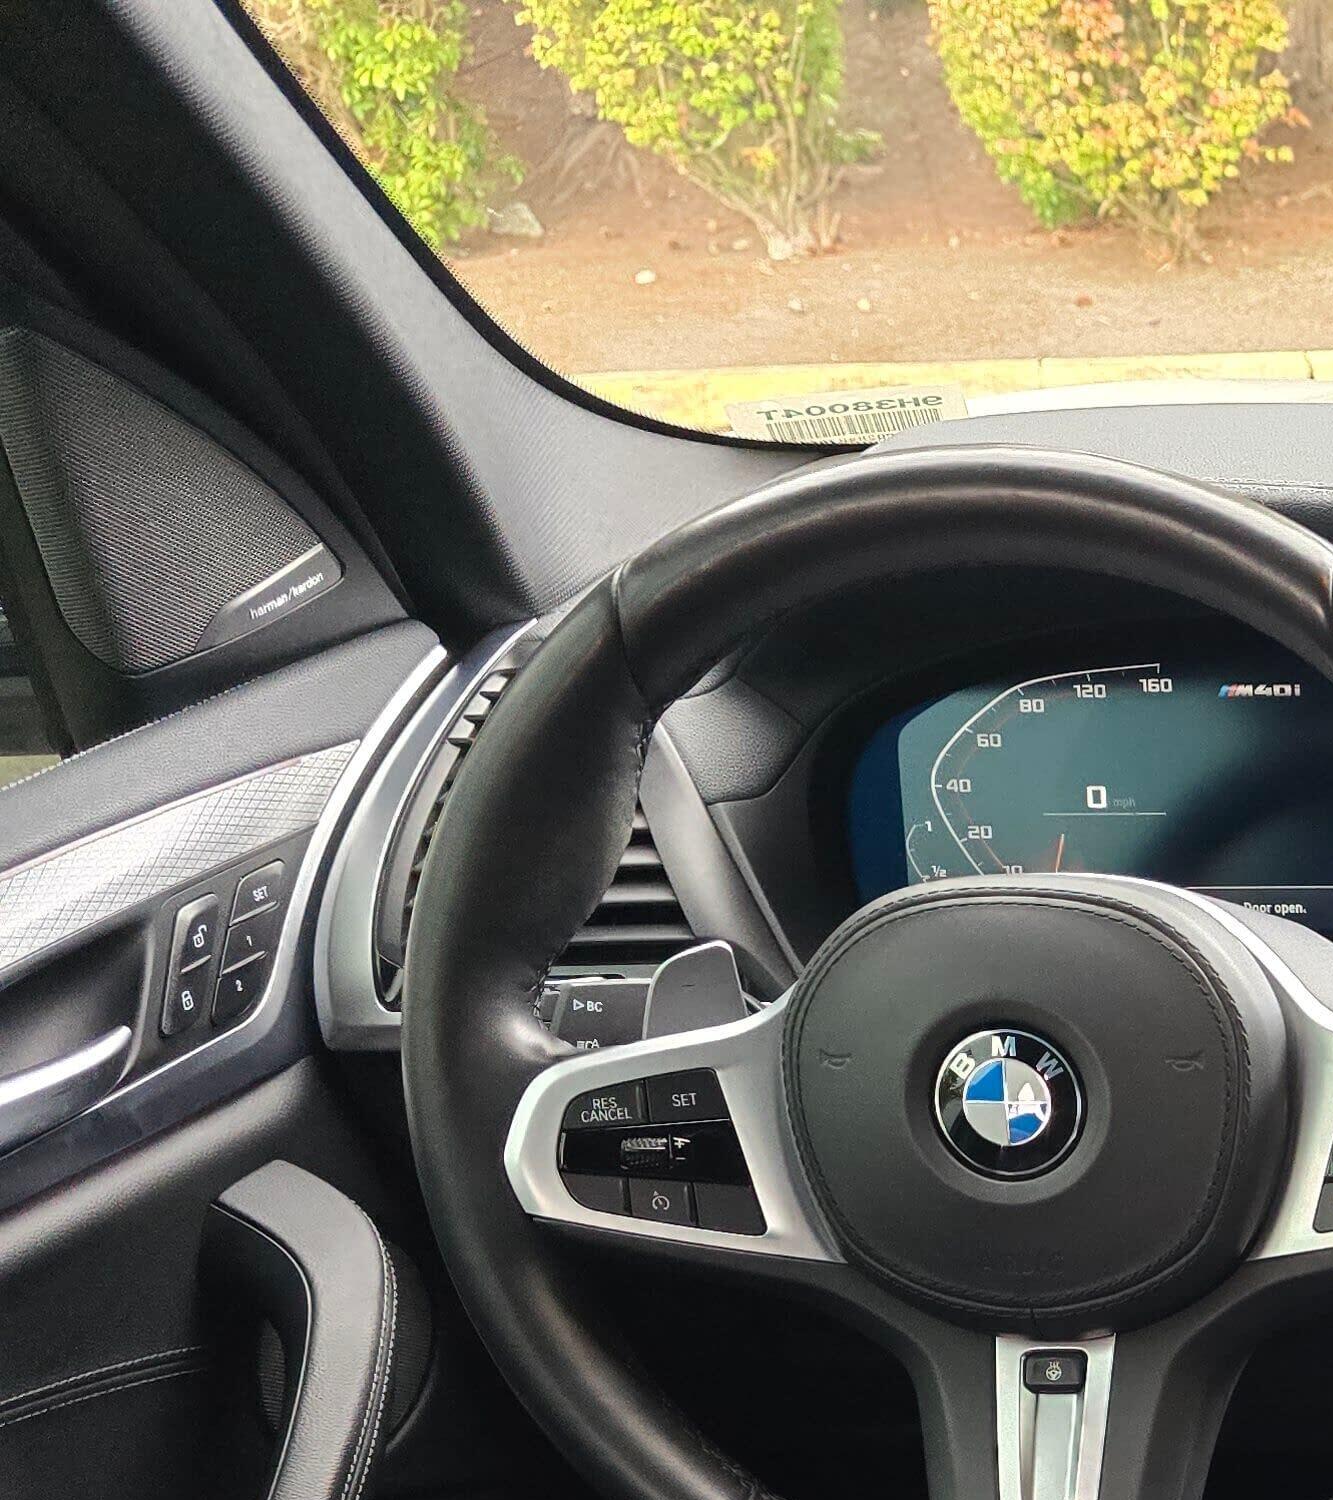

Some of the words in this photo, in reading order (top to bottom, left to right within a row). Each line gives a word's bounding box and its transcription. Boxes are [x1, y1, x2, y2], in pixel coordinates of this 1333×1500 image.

[1073, 684, 1106, 698] 120
[1139, 678, 1172, 693] 160
[1019, 698, 1045, 713] 80
[976, 733, 1002, 748] 60
[946, 778, 971, 793] 40
[1086, 785, 1108, 809] 0
[967, 825, 993, 839] 20
[252, 886, 268, 901] SET
[235, 979, 244, 992] 2
[587, 1001, 603, 1013] BC
[949, 1035, 1064, 1081] BMW
[592, 1097, 618, 1110] RES
[671, 1092, 697, 1108] SET
[581, 1107, 632, 1122] CANCEL
